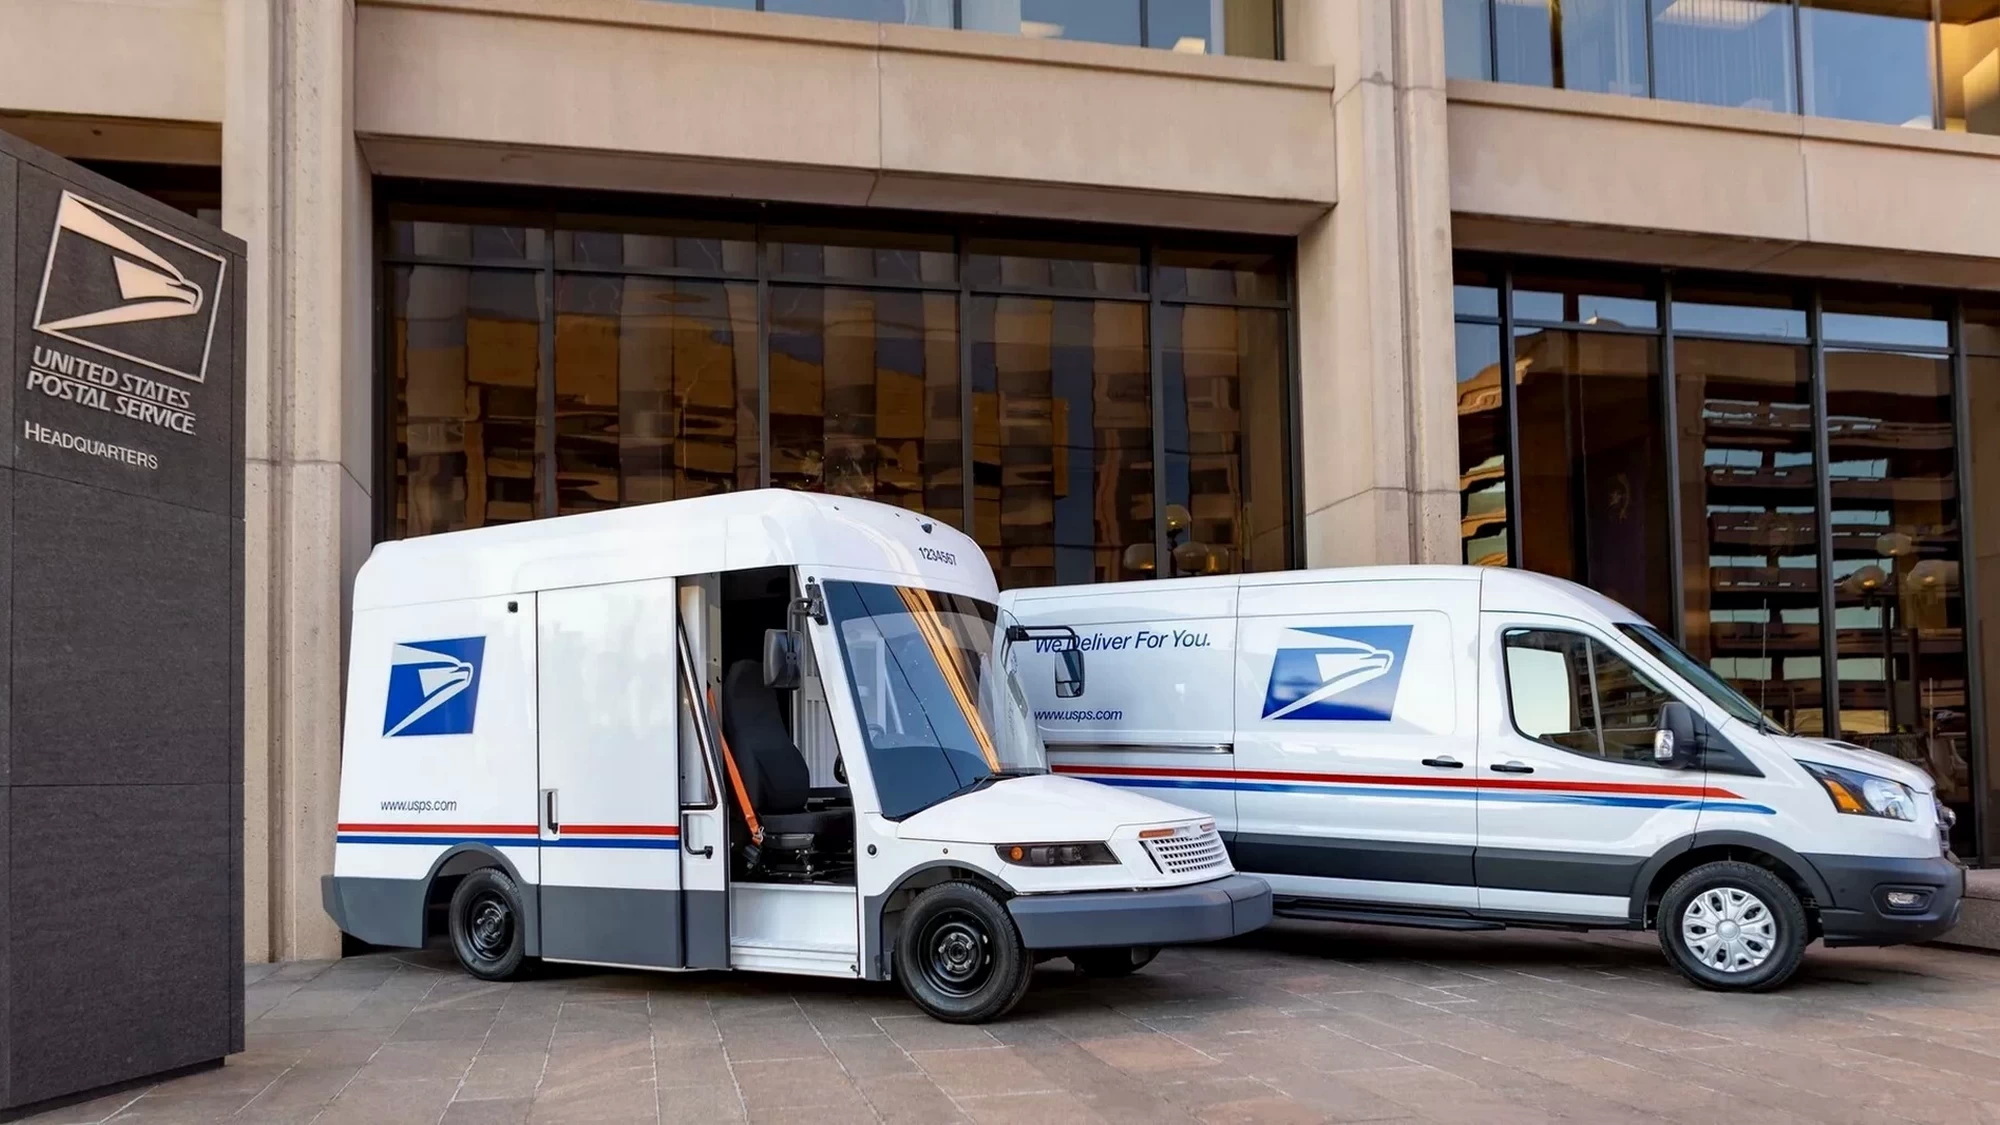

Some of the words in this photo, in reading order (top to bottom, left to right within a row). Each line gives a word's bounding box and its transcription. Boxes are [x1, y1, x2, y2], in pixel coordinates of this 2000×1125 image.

[33, 345, 118, 387] UNITED
[120, 373, 191, 409] STATES
[26, 370, 111, 412] POSTAL
[24, 420, 158, 470] HEADQUARTERS
[918, 547, 957, 566] 1234567
[1035, 637, 1062, 653] We
[1066, 633, 1132, 651] Deliver
[1134, 631, 1169, 649] For
[1173, 629, 1211, 648] You.
[1033, 710, 1122, 722] www.usps.com
[380, 800, 457, 814] www.usps.com
